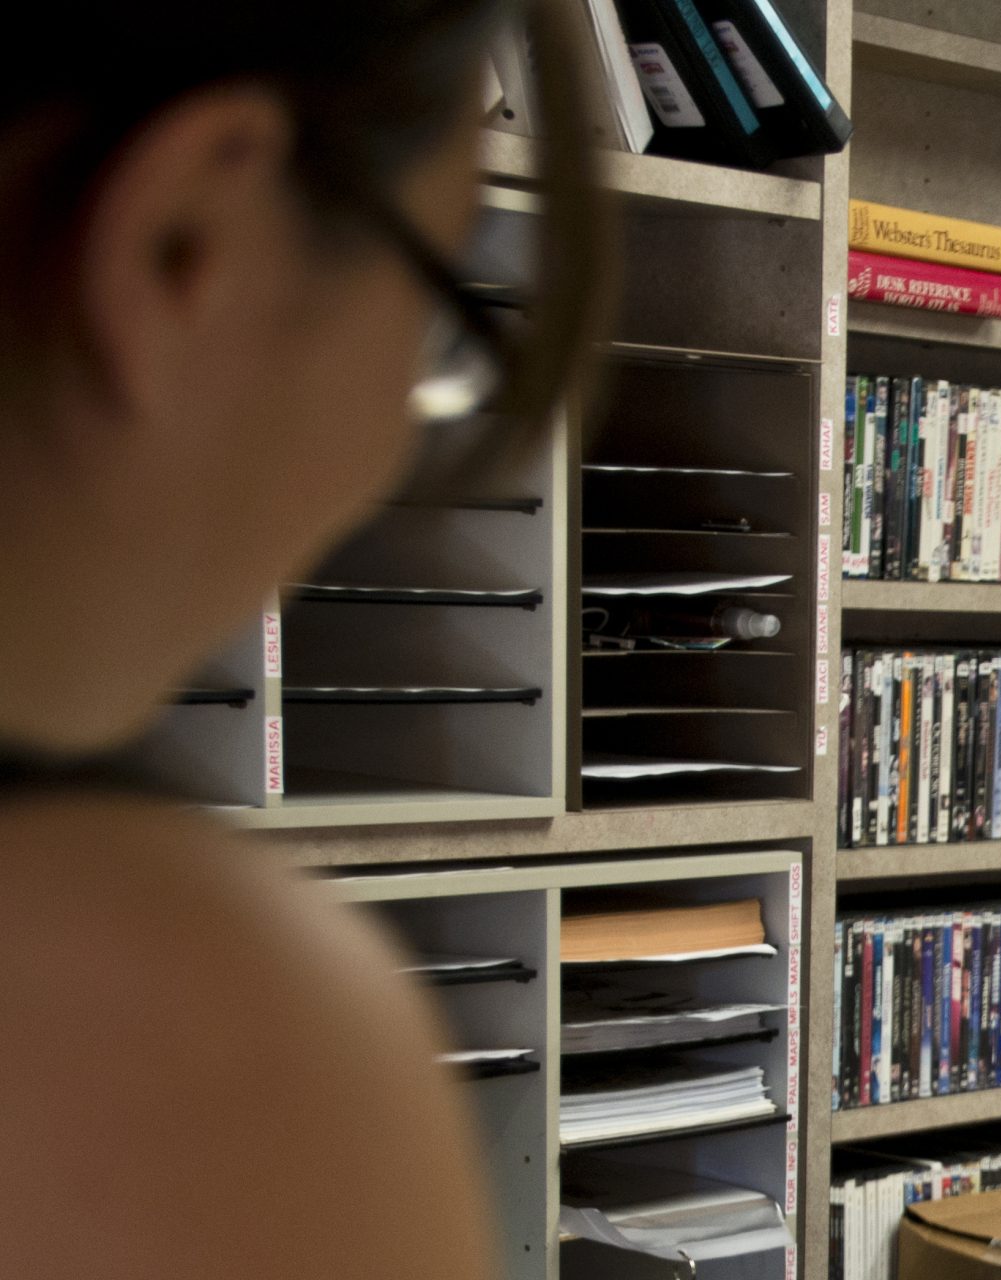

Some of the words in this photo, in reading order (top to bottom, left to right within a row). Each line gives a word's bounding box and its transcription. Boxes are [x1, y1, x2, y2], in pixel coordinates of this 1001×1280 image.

[873, 219, 932, 249] Webster's
[934, 229, 1001, 260] Thesaurus
[876, 274, 907, 291] DESK
[909, 278, 972, 302] REFERENCE
[828, 297, 839, 334] KATE
[820, 494, 829, 524] SAM
[819, 537, 828, 599] SHALANE
[267, 615, 279, 673] LESLEY
[818, 610, 827, 651] SHANE
[818, 662, 827, 702] TRACI
[268, 720, 280, 790] MARISSA
[791, 864, 801, 898] LOGS
[790, 904, 800, 941] SHIFT
[790, 948, 799, 985] MAPS
[789, 1031, 798, 1066] MAPS
[788, 1073, 797, 1105] PAUL
[787, 1142, 796, 1172] INFO
[787, 1178, 795, 1212] TOUR
